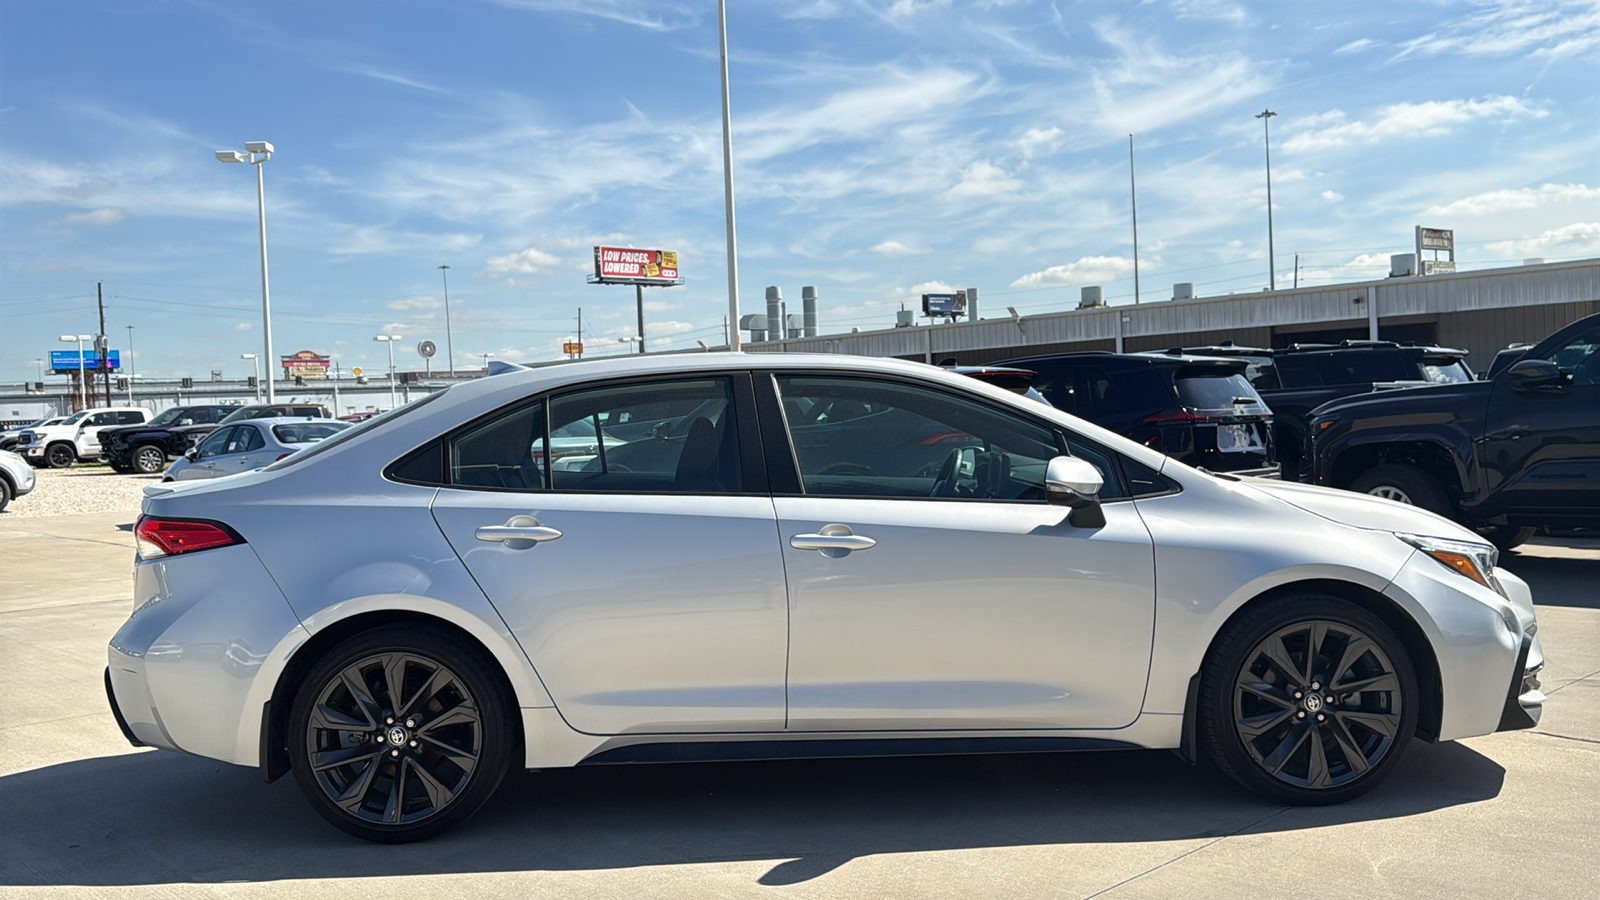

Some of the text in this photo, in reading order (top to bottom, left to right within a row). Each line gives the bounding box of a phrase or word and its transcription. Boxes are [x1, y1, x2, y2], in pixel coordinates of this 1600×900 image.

[603, 250, 621, 262] LOW
[620, 252, 650, 264] PRICES,
[604, 262, 640, 274] LOWERED
